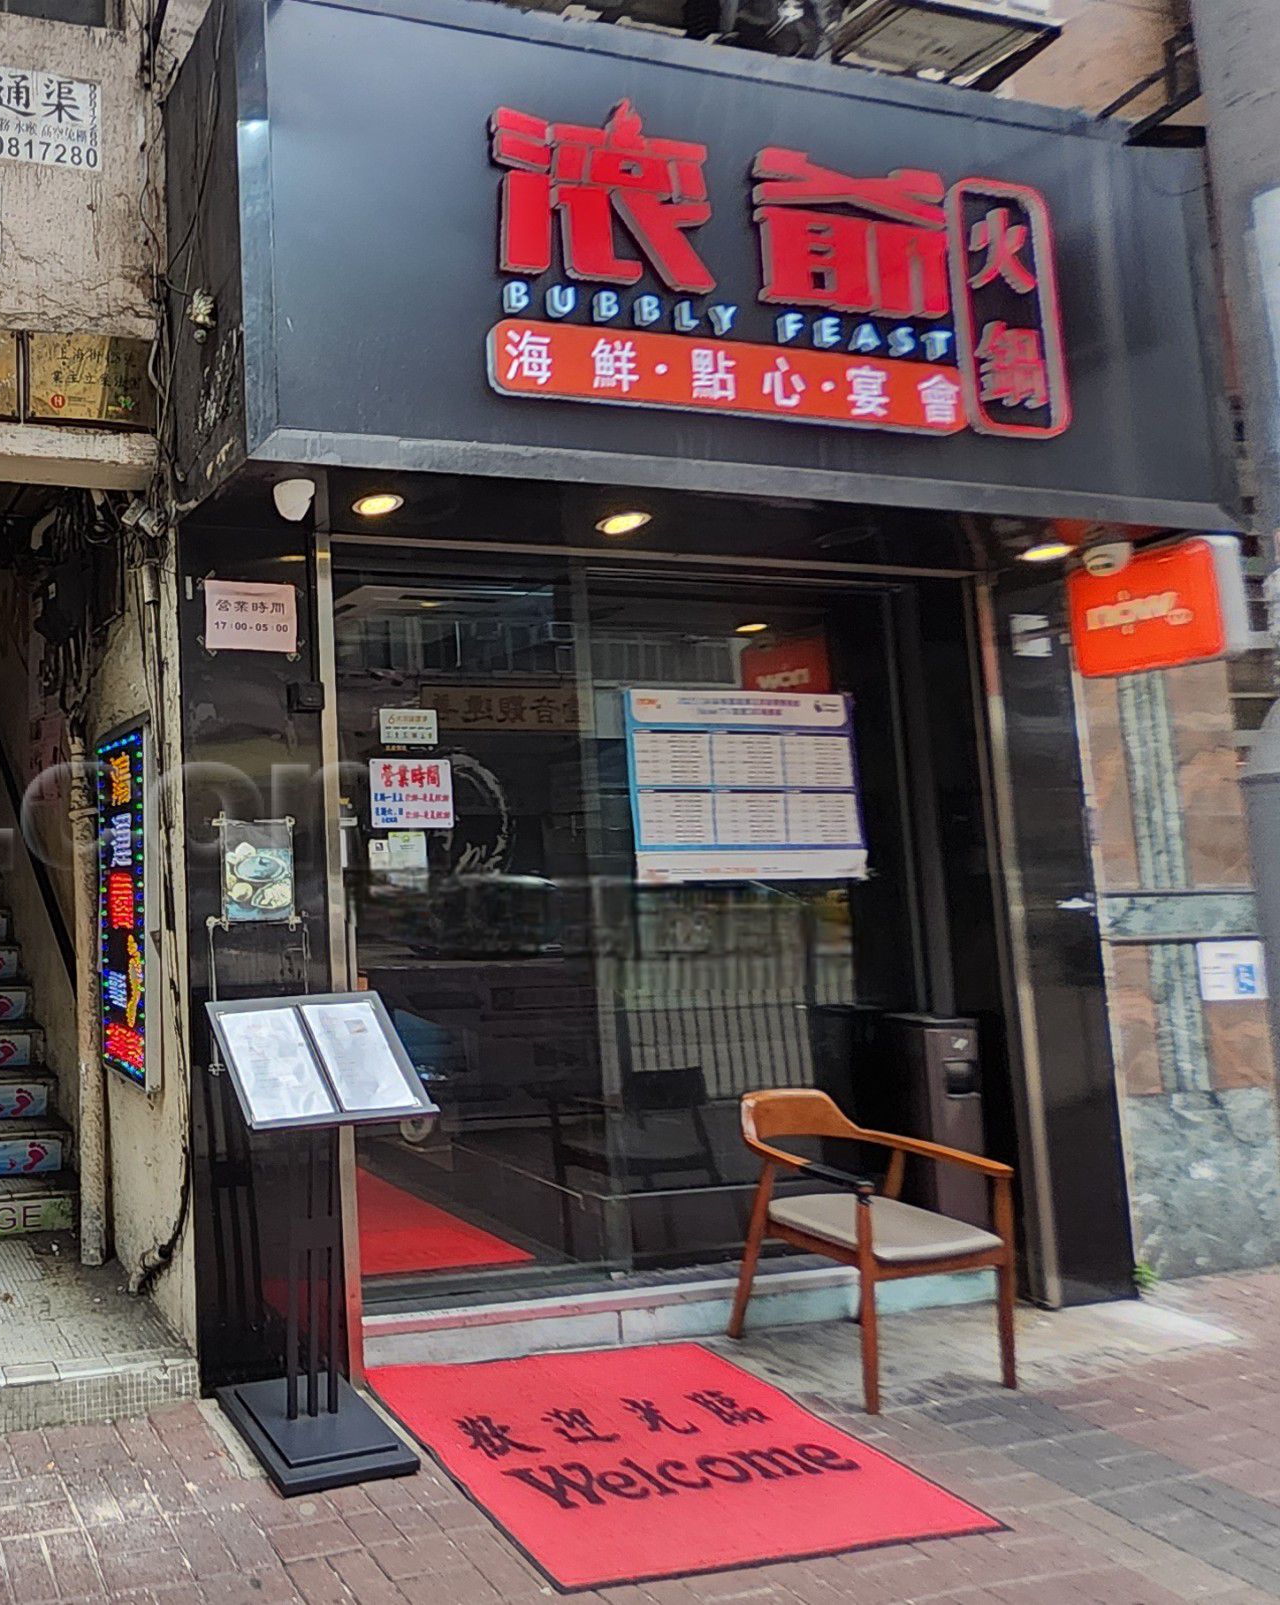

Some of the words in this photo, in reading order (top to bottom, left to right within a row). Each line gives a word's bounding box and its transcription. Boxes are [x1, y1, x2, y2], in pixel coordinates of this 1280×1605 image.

[502, 280, 738, 337] BUBBLY
[776, 311, 956, 361] FEAST
[216, 599, 286, 615] 營業時間
[381, 763, 440, 788] 營業時間
[501, 1442, 861, 1510] Welcome
